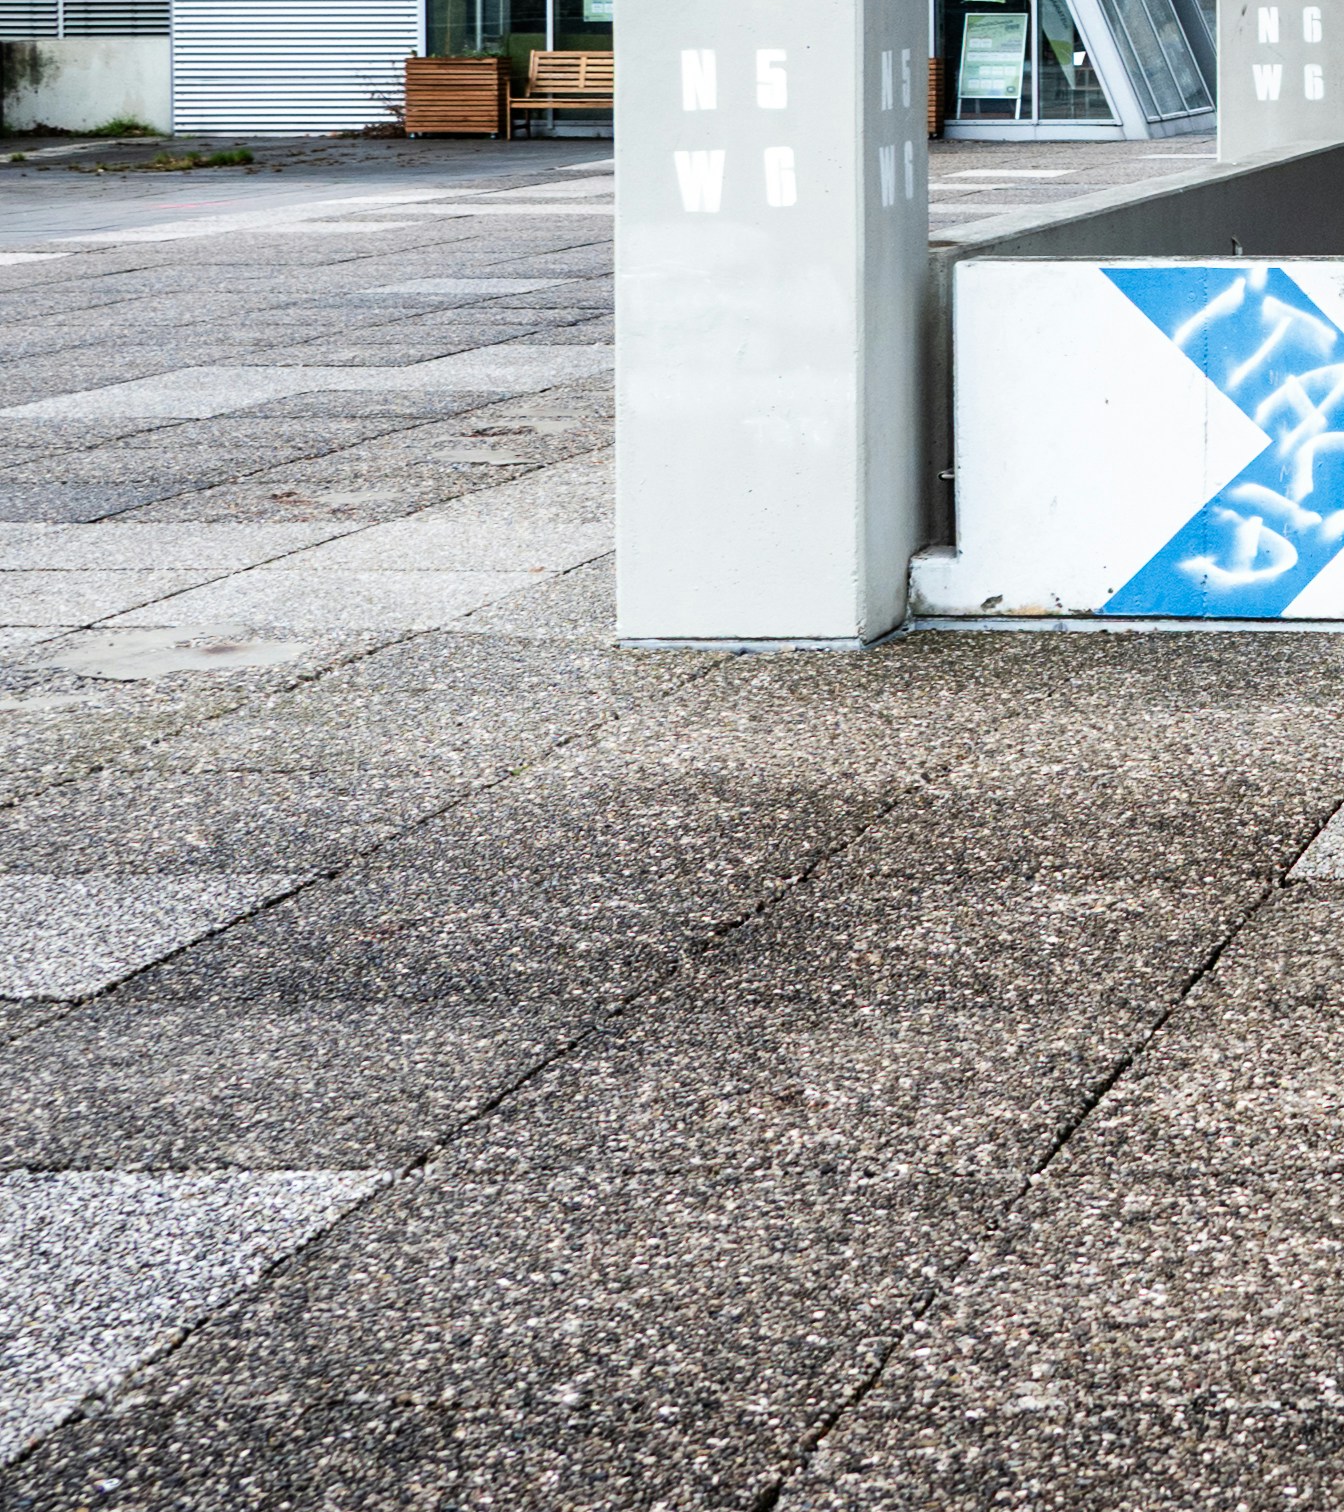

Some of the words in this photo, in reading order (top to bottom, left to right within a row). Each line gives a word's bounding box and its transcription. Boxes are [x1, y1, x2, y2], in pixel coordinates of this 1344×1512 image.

[1258, 6, 1280, 43] N
[1303, 6, 1323, 43] 6
[681, 49, 717, 111] N
[756, 48, 788, 109] 5
[881, 50, 893, 112] N
[902, 48, 911, 108] 5
[1252, 64, 1283, 101] W
[1304, 63, 1325, 101] 6
[674, 149, 726, 214] W
[764, 146, 798, 208] 6
[879, 144, 895, 208] W
[904, 140, 914, 200] 6
